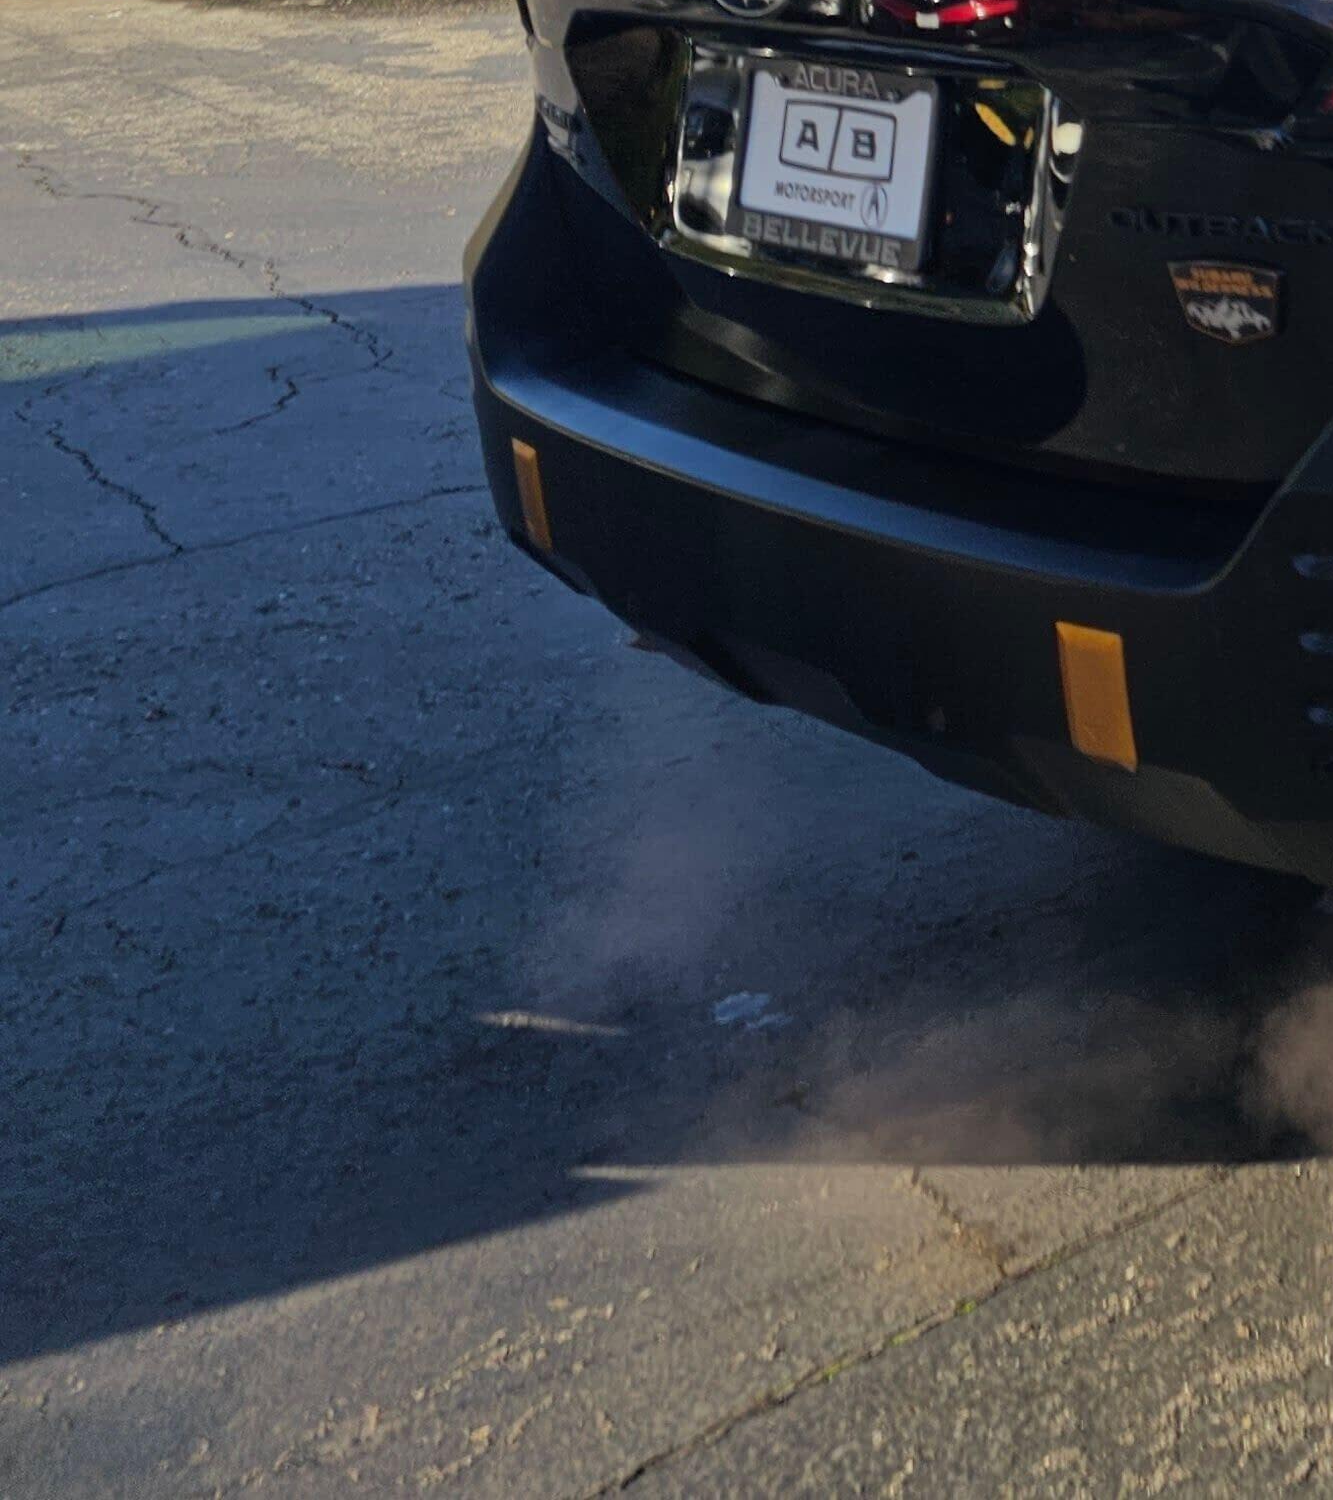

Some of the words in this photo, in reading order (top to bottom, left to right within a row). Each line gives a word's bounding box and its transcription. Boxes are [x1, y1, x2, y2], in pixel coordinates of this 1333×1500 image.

[793, 62, 880, 101] ACURA
[796, 119, 819, 151] A
[851, 129, 877, 161] B
[774, 180, 856, 210] MOTORSPORT
[743, 213, 902, 267] BELLEVUE
